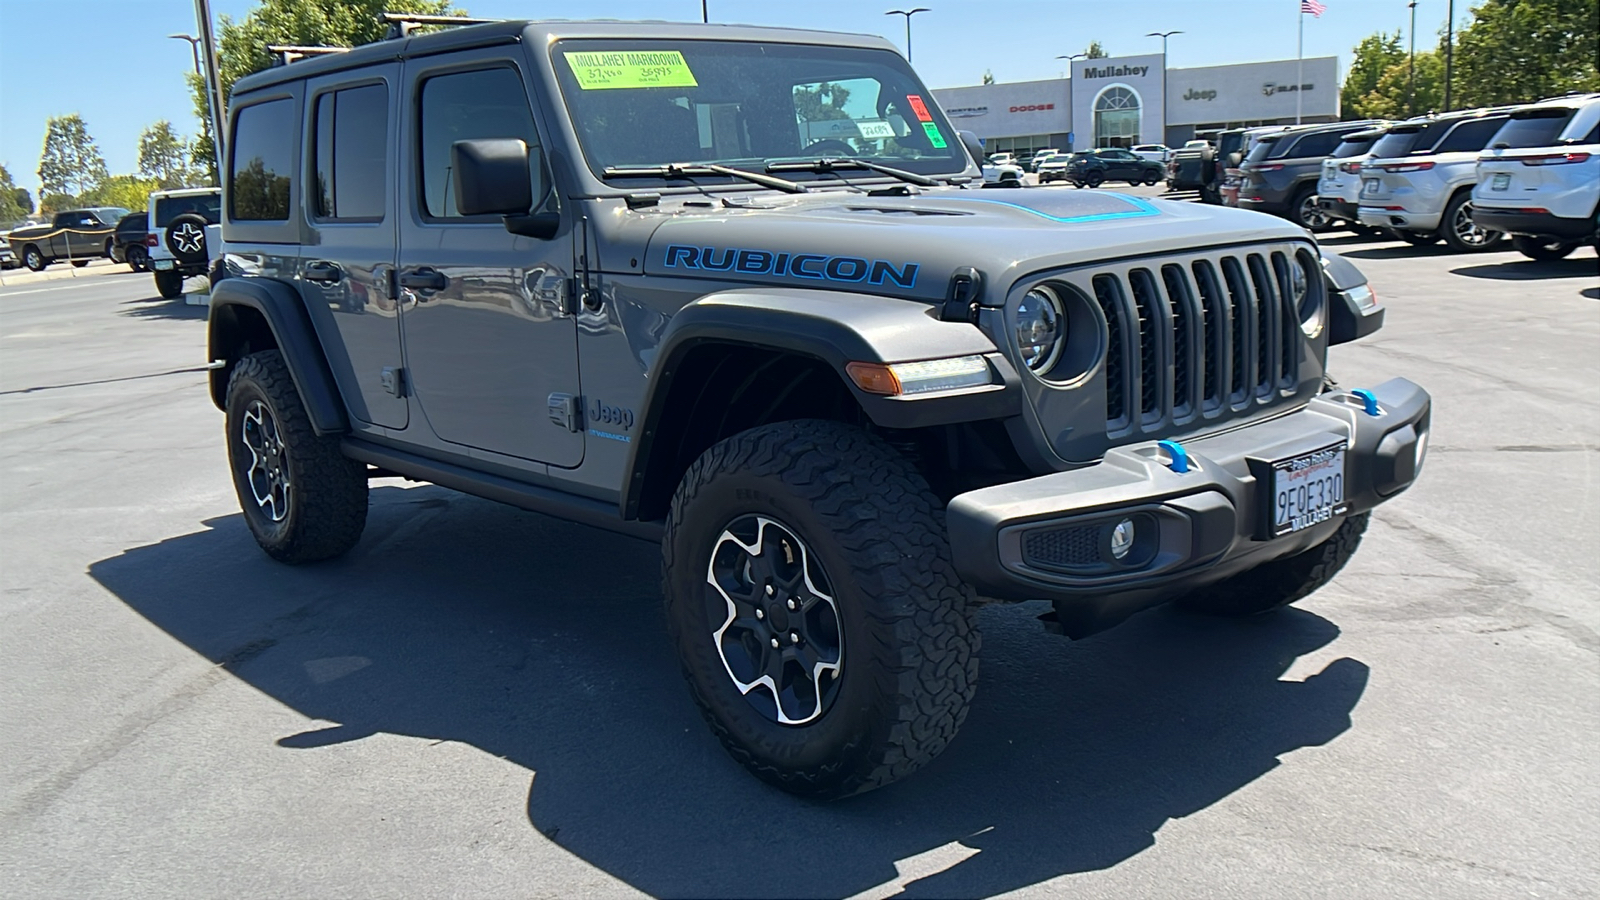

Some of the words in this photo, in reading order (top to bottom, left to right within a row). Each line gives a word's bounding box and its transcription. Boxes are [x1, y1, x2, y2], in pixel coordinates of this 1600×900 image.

[575, 54, 626, 67] MULLAHEY
[627, 53, 682, 66] MARKDOWN
[1084, 65, 1149, 80] Mullahey
[1183, 88, 1217, 101] Jeep
[1009, 103, 1055, 113] DODGE
[664, 244, 921, 289] RUBICON
[589, 400, 634, 432] Jeep
[1292, 506, 1332, 532] MULLAHEY
